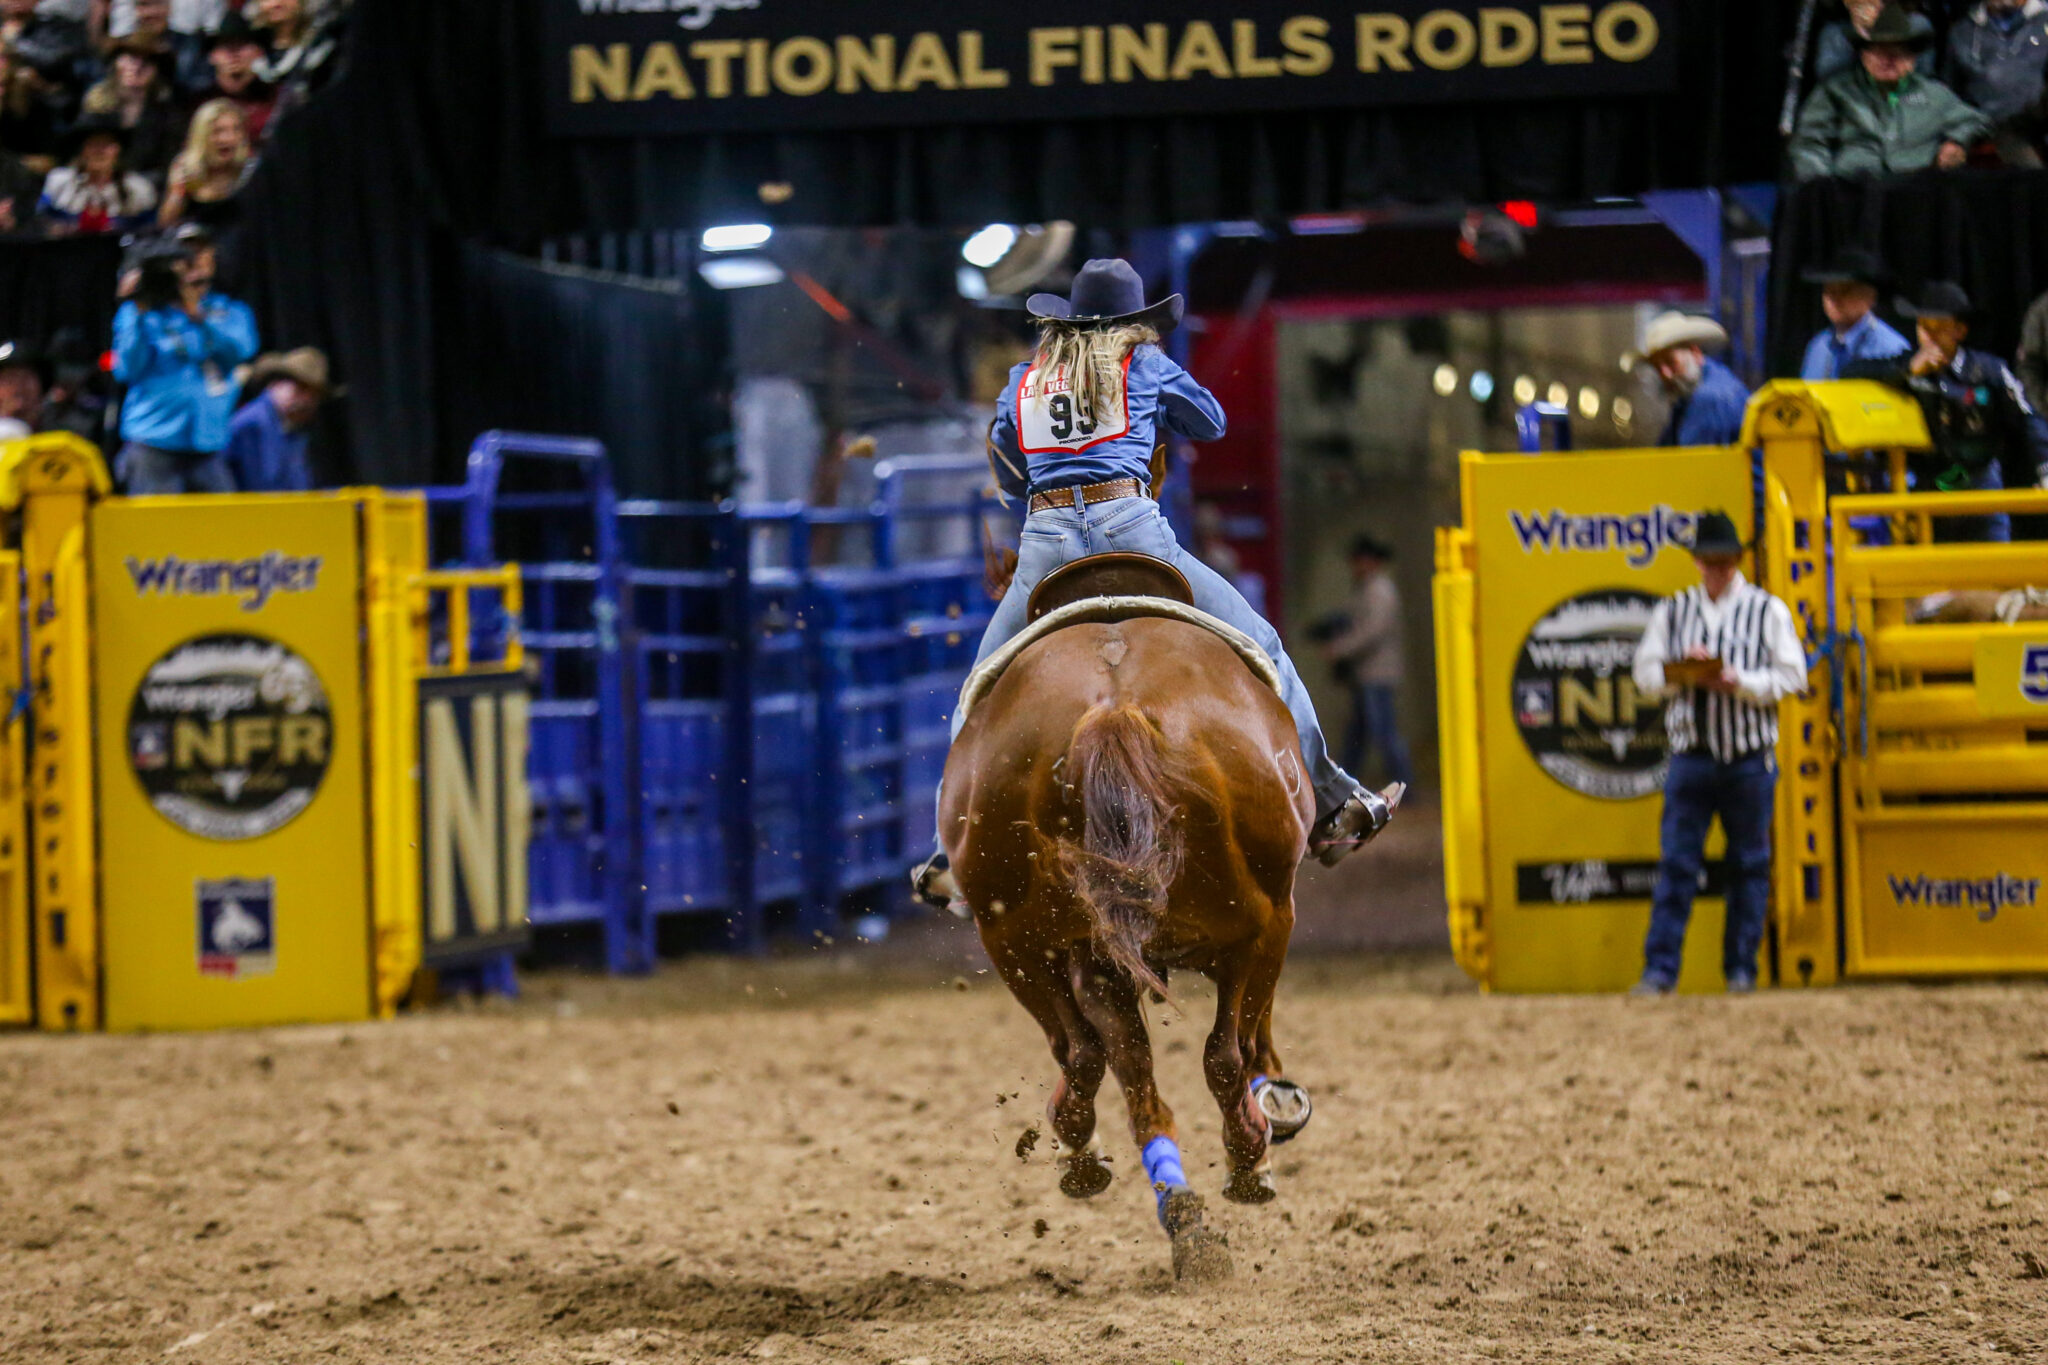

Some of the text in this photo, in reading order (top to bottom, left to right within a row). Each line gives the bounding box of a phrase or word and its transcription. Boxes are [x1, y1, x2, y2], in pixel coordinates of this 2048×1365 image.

[569, 0, 1660, 103] NATIONAL FINALS RODEO
[1508, 503, 1706, 569] Wrangle
[124, 550, 323, 612] Wrangler
[2018, 641, 2048, 705] 5
[172, 716, 326, 768] NFR
[1887, 872, 2041, 921] Wrangler
